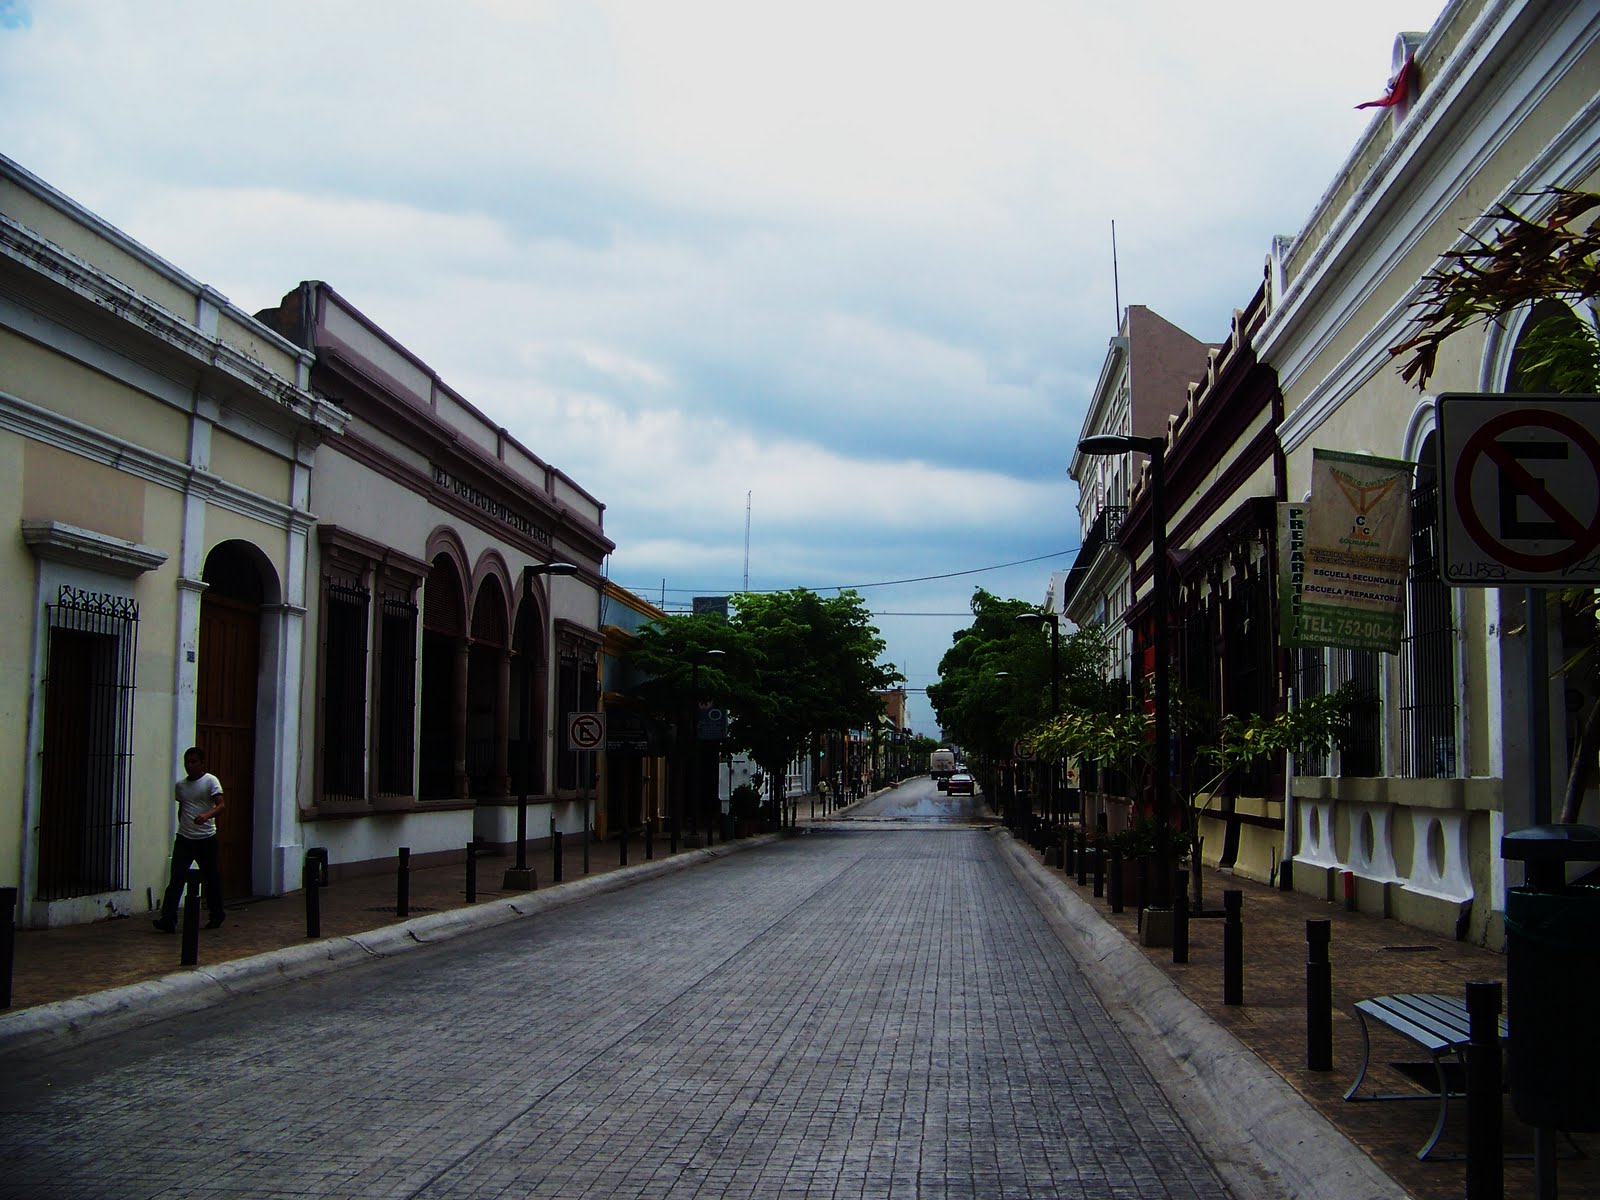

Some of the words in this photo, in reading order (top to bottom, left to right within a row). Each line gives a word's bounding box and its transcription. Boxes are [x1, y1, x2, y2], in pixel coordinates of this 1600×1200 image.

[435, 466, 450, 489] EL
[454, 480, 498, 516] COLEGIO
[500, 503, 512, 524] DE
[1313, 568, 1351, 580] ESCUELA
[1352, 573, 1403, 586] SECUNDARIA
[1304, 584, 1342, 595] ESCUELA
[1344, 589, 1403, 603] PREPARATORIA
[1302, 614, 1332, 633] TEL:
[1300, 633, 1360, 647] INSCRIPCIONES
